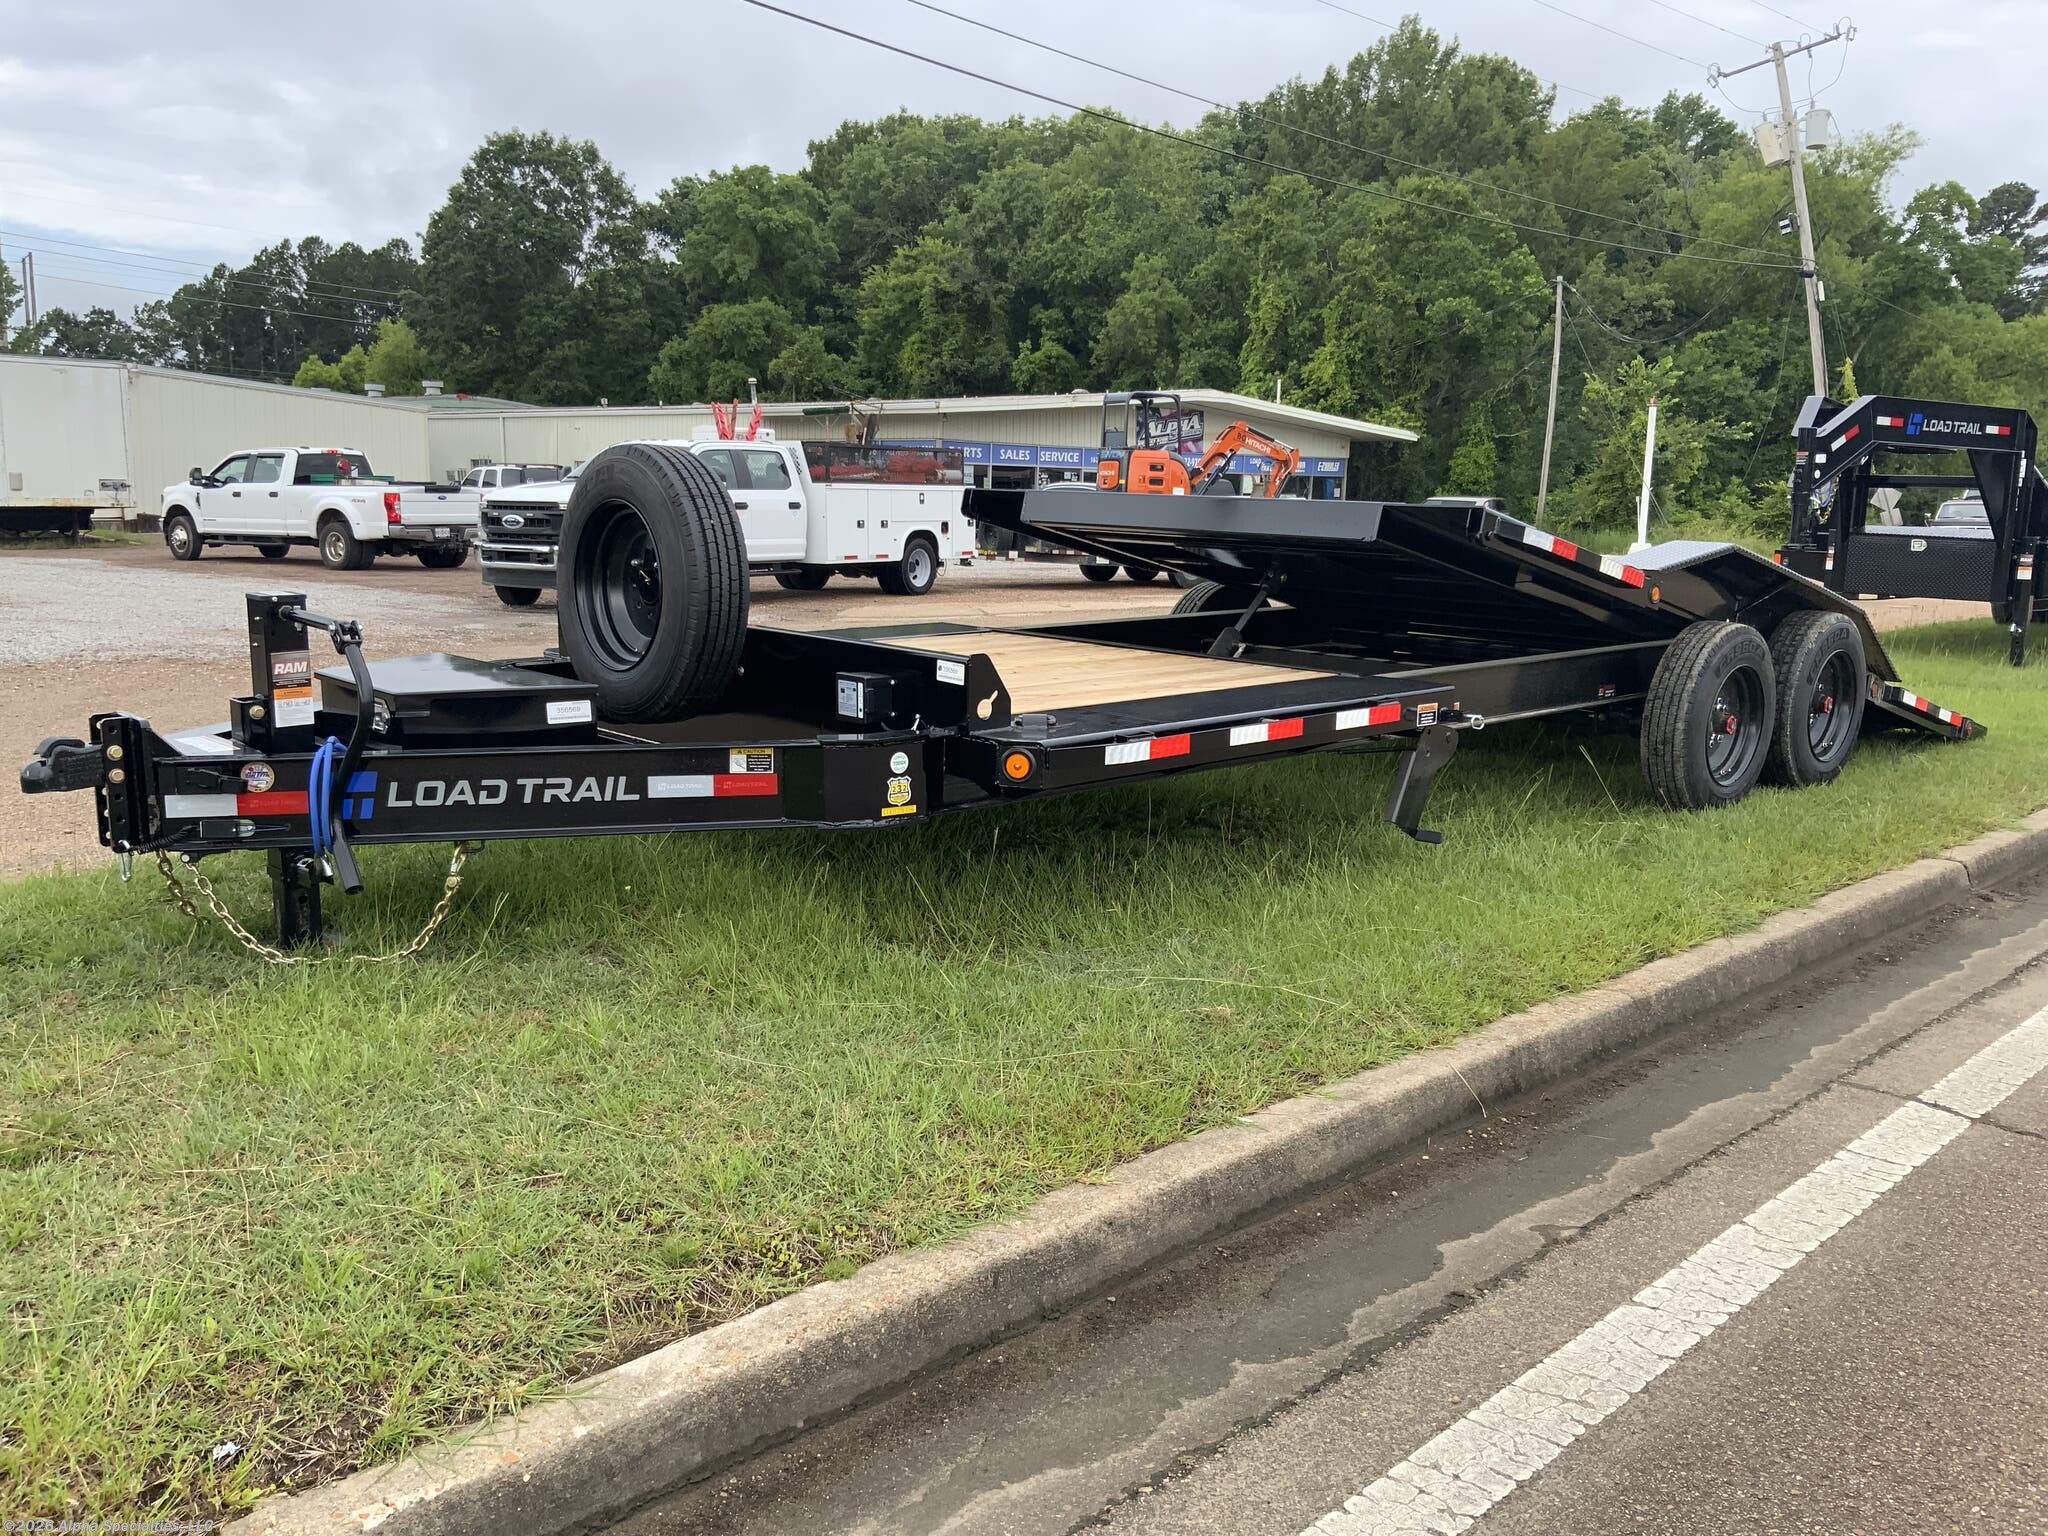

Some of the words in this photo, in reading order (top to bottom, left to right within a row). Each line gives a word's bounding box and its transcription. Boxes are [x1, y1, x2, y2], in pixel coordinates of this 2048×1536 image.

[1922, 419, 1952, 433] LOAD
[1953, 421, 1982, 435] TRAIL
[1245, 437, 1272, 455] HITACHI
[1000, 449, 1031, 462] SALES
[1040, 451, 1080, 463] SERVICE
[273, 661, 308, 675] RAM
[386, 779, 509, 808] LOAD
[516, 775, 640, 804] TRAIL
